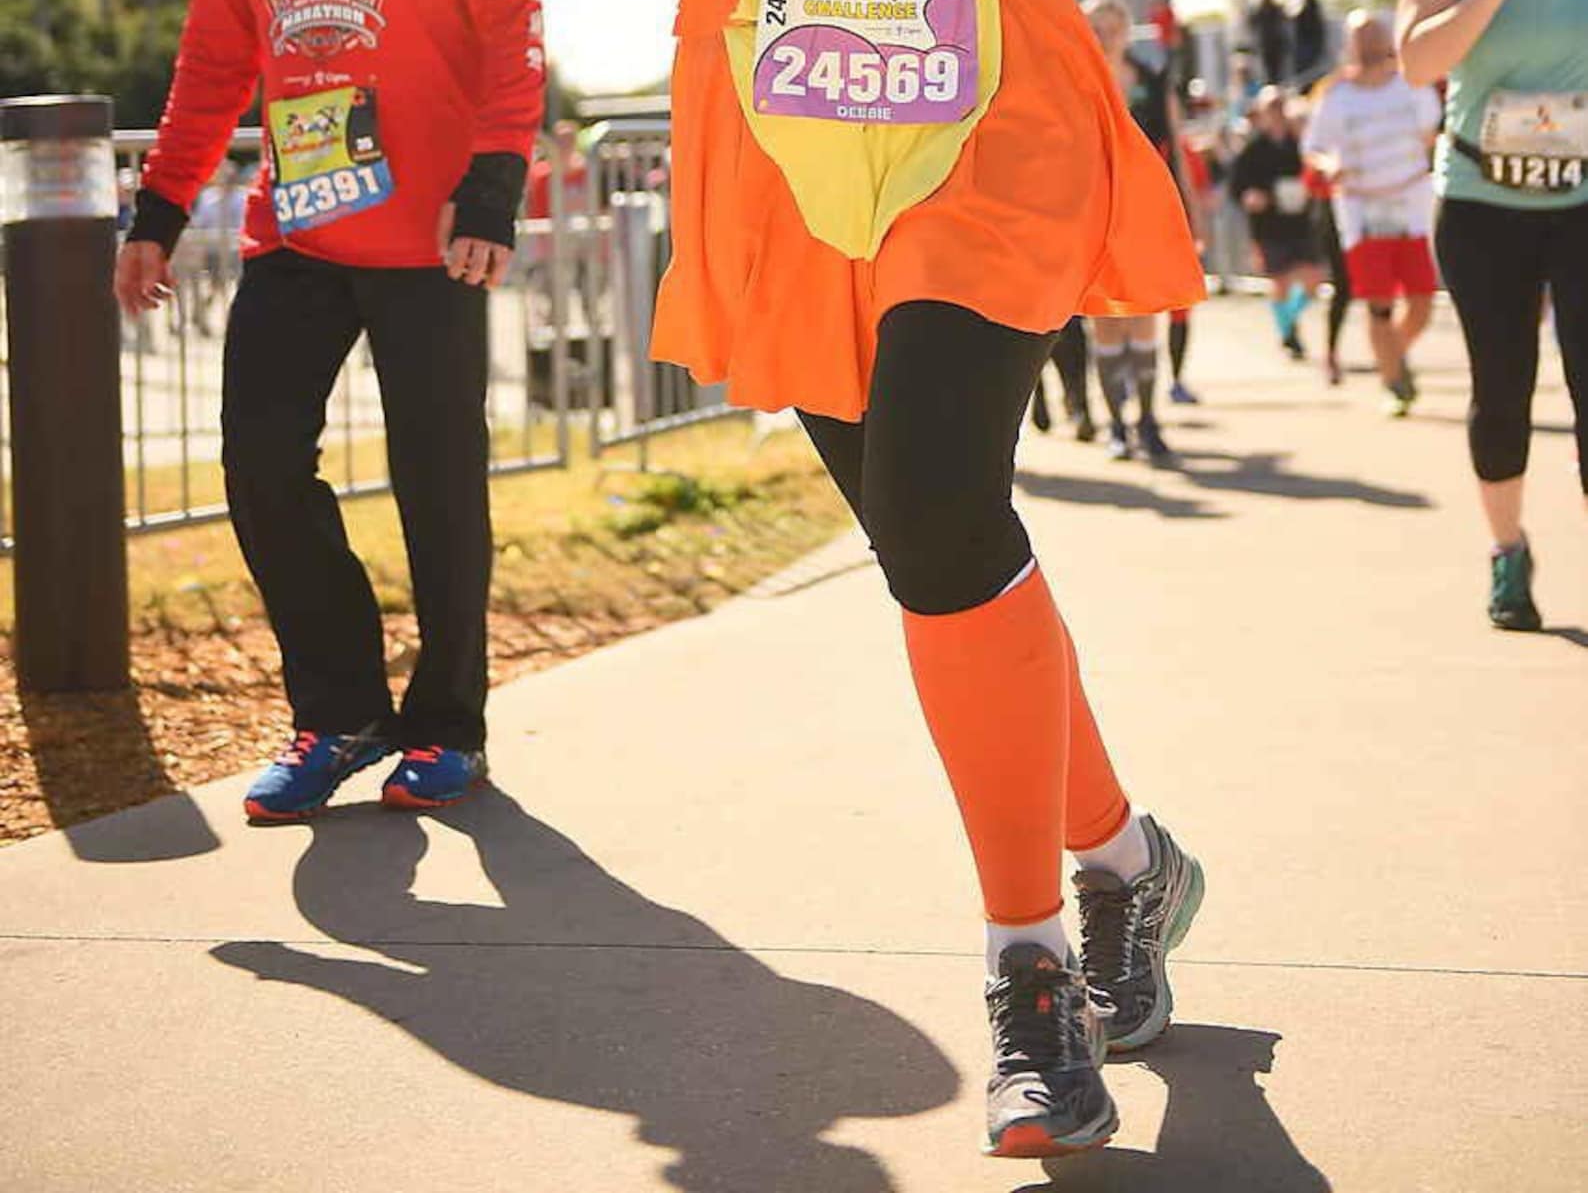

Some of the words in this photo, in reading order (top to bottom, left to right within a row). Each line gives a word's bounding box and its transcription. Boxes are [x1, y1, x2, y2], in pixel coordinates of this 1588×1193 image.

[771, 45, 960, 104] 24569
[274, 167, 380, 223] 32391
[1490, 155, 1582, 187] 11214
